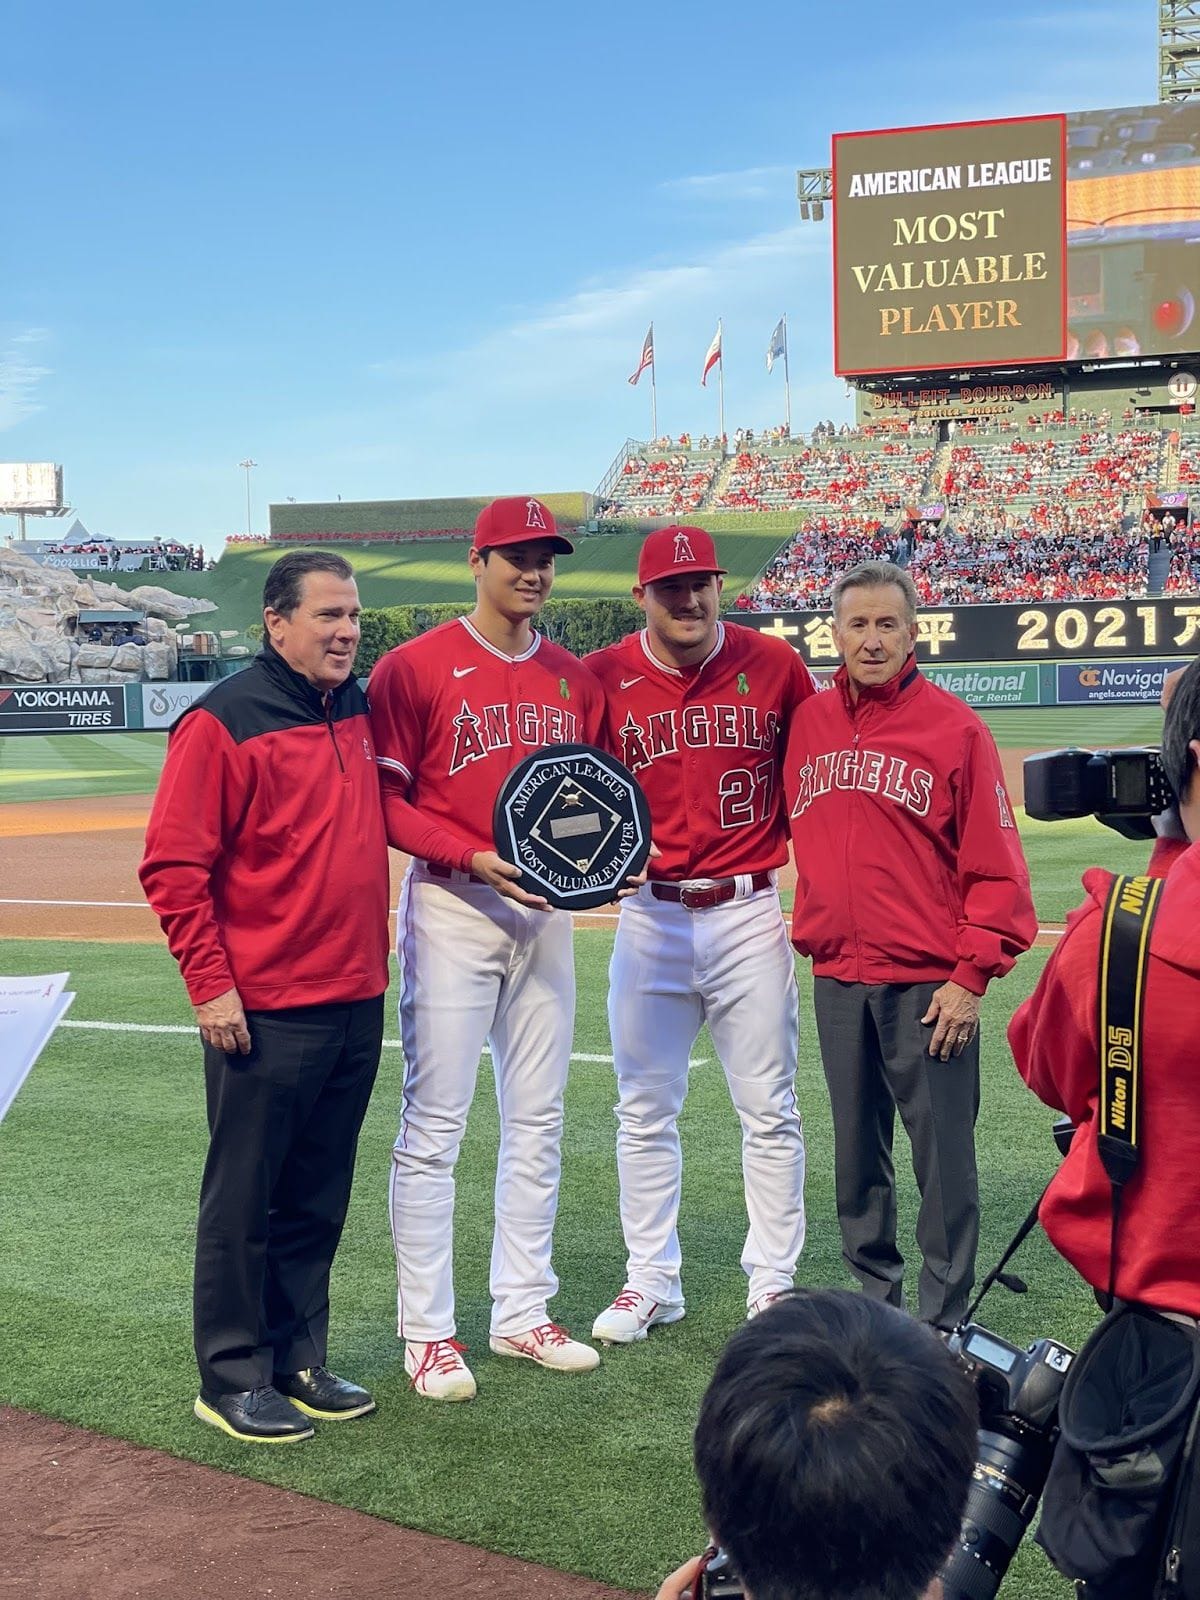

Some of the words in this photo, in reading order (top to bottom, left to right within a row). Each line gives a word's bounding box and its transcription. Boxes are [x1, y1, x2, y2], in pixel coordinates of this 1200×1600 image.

[848, 165, 962, 198] AMERICAN
[967, 158, 1052, 188] LEAGUE
[893, 208, 1006, 246] MOST
[851, 252, 1048, 294] VALUABLE
[879, 299, 1022, 336] PLAYER
[872, 388, 951, 409] BULLEIT
[960, 382, 1054, 404] BOURBON
[525, 499, 547, 529] A
[673, 532, 697, 563] A
[14, 690, 110, 707] YOKOHAMA
[935, 671, 1026, 692] National
[965, 693, 984, 702] Car
[986, 692, 1022, 702] Rental
[68, 712, 112, 726] TIRES
[449, 699, 583, 776] ANGEL
[619, 704, 778, 774] ANGELS
[513, 762, 571, 818] AMERICAN
[574, 762, 627, 801] LEAGUE
[718, 758, 775, 829] 27
[790, 750, 934, 818] ANGELS
[517, 838, 547, 875] MOST
[547, 866, 615, 890] VALUABLE
[610, 821, 634, 873] PLAYER
[1107, 1025, 1133, 1071] D5
[1111, 1076, 1127, 1130] Nikon
